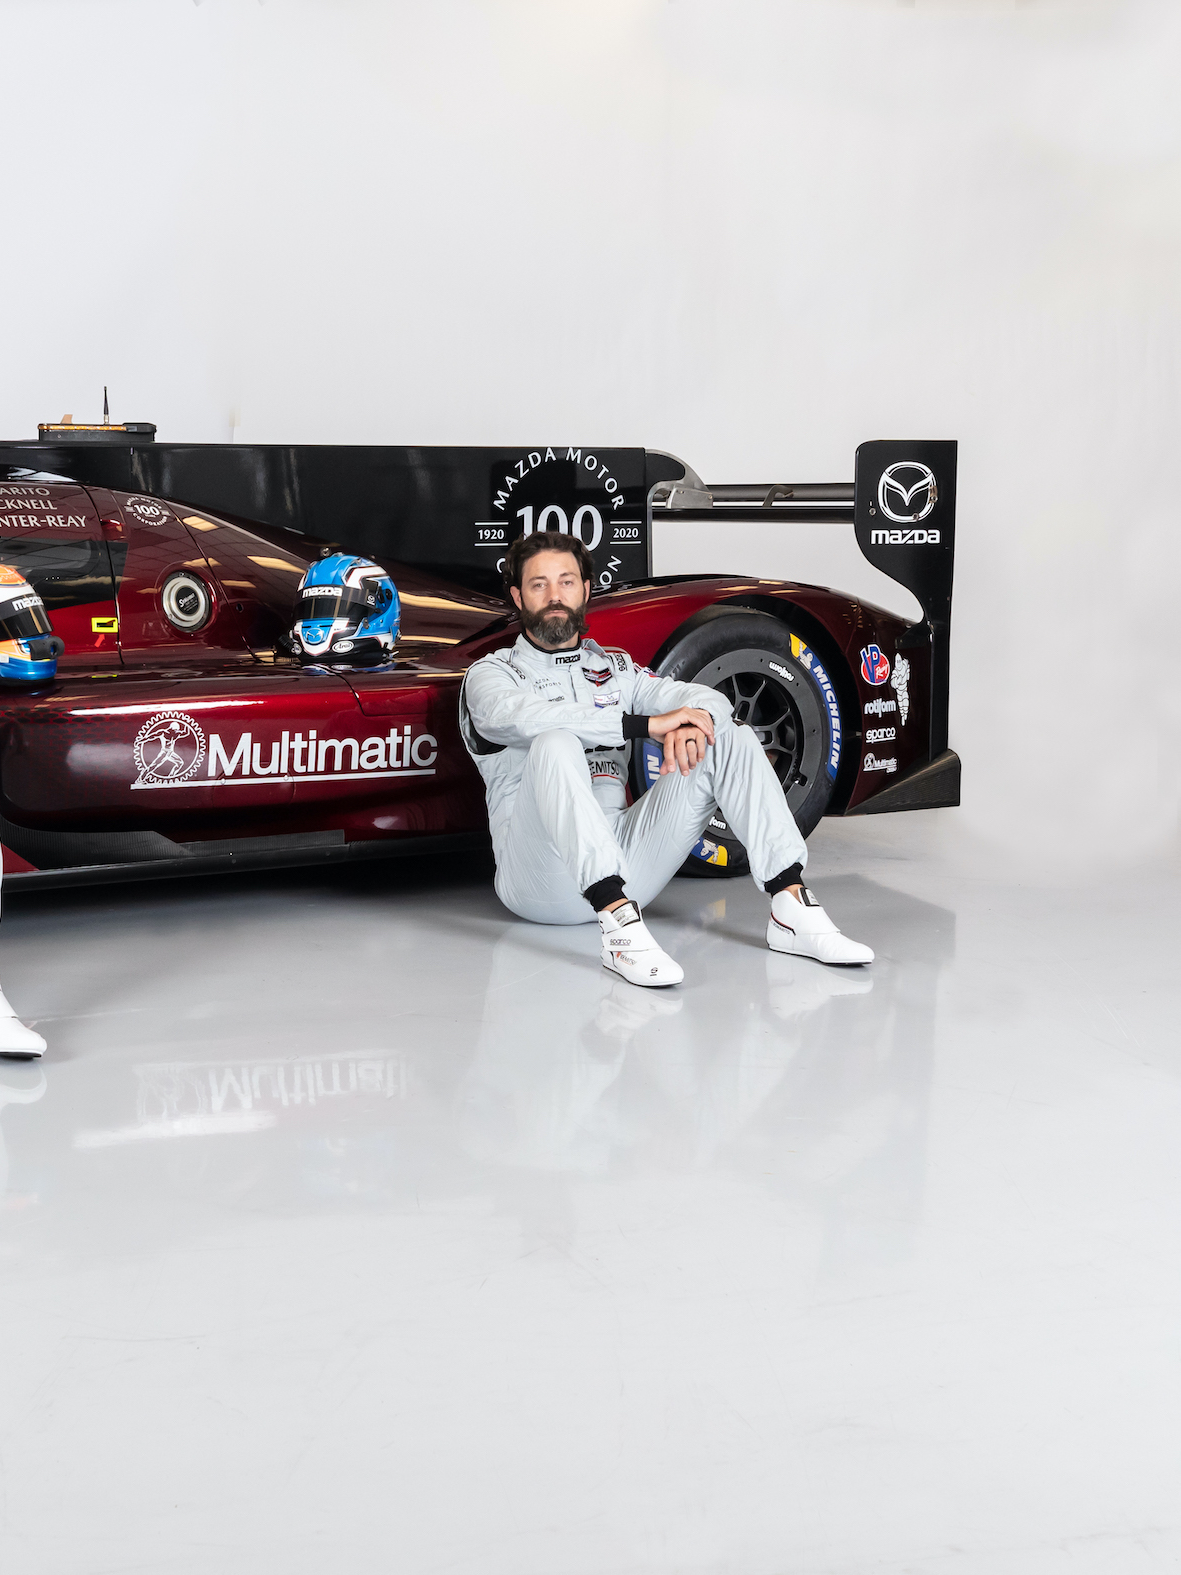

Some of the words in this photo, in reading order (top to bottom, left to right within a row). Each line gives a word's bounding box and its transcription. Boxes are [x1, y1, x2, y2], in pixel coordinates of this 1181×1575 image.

[493, 447, 556, 511] MAZDA
[566, 447, 625, 510] MOTOR
[134, 504, 160, 516] 100
[477, 529, 505, 540] 1920
[612, 527, 639, 539] 2020
[812, 664, 842, 770] MICHELIN
[864, 697, 897, 719] rotiform
[865, 726, 897, 744] sparco
[206, 724, 438, 777] Multimatic
